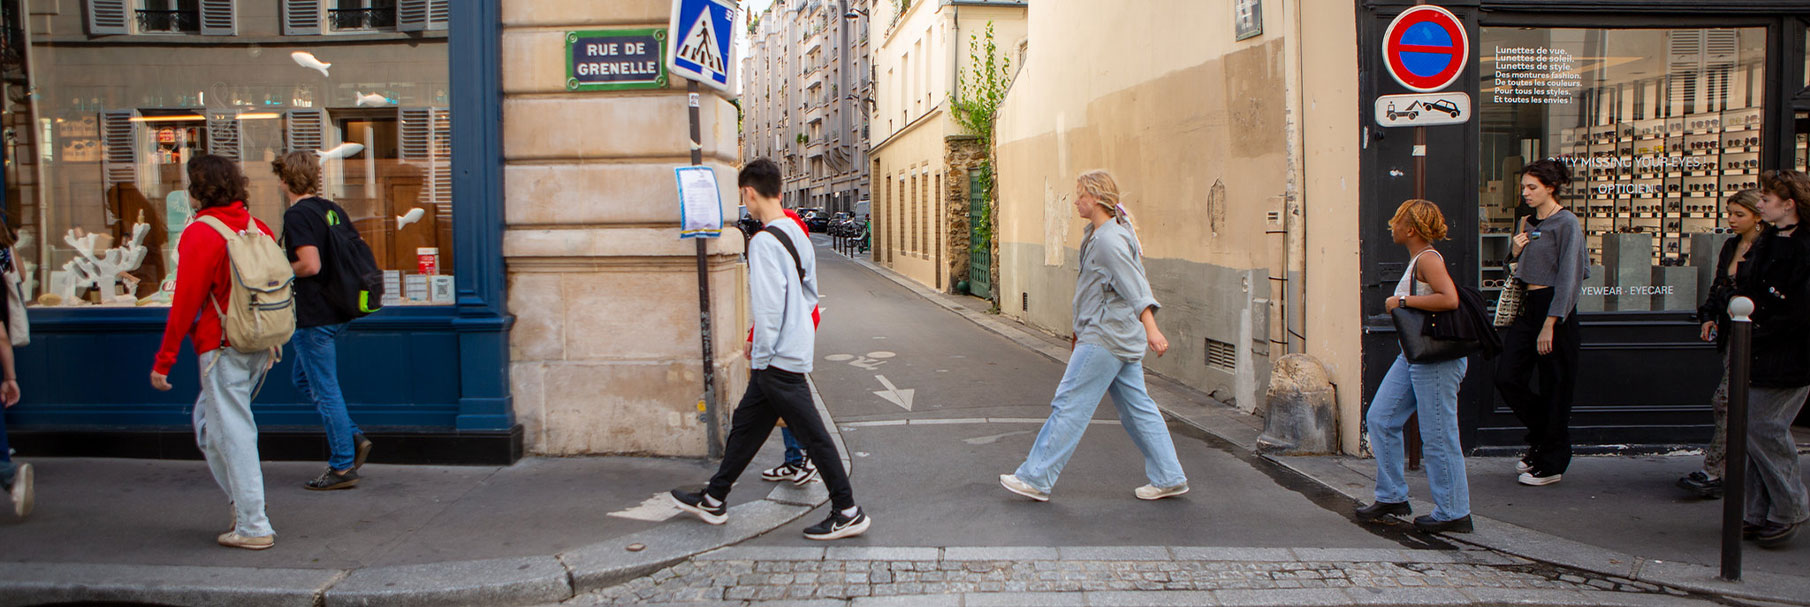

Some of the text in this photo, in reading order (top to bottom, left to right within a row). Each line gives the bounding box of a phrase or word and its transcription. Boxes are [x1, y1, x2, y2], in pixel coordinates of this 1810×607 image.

[587, 42, 646, 56] RUE DE
[1495, 45, 1535, 55] Lunettes
[1536, 46, 1548, 55] de
[1495, 54, 1575, 63] Lunettes de soleil.
[577, 61, 657, 76] GRENELLE
[1495, 62, 1573, 72] Lunettes de style.
[1494, 87, 1513, 95] Pour
[1546, 88, 1572, 97] styles.
[1493, 95, 1503, 103] Et
[1548, 157, 1577, 167] LY
[1581, 157, 1632, 168] MISSING
[1634, 156, 1668, 168] YOUR
[1672, 156, 1700, 167] EYES
[1598, 183, 1655, 194] OPTICIEN
[1581, 286, 1622, 296] YEWEAR
[1630, 285, 1674, 295] EYECARE
